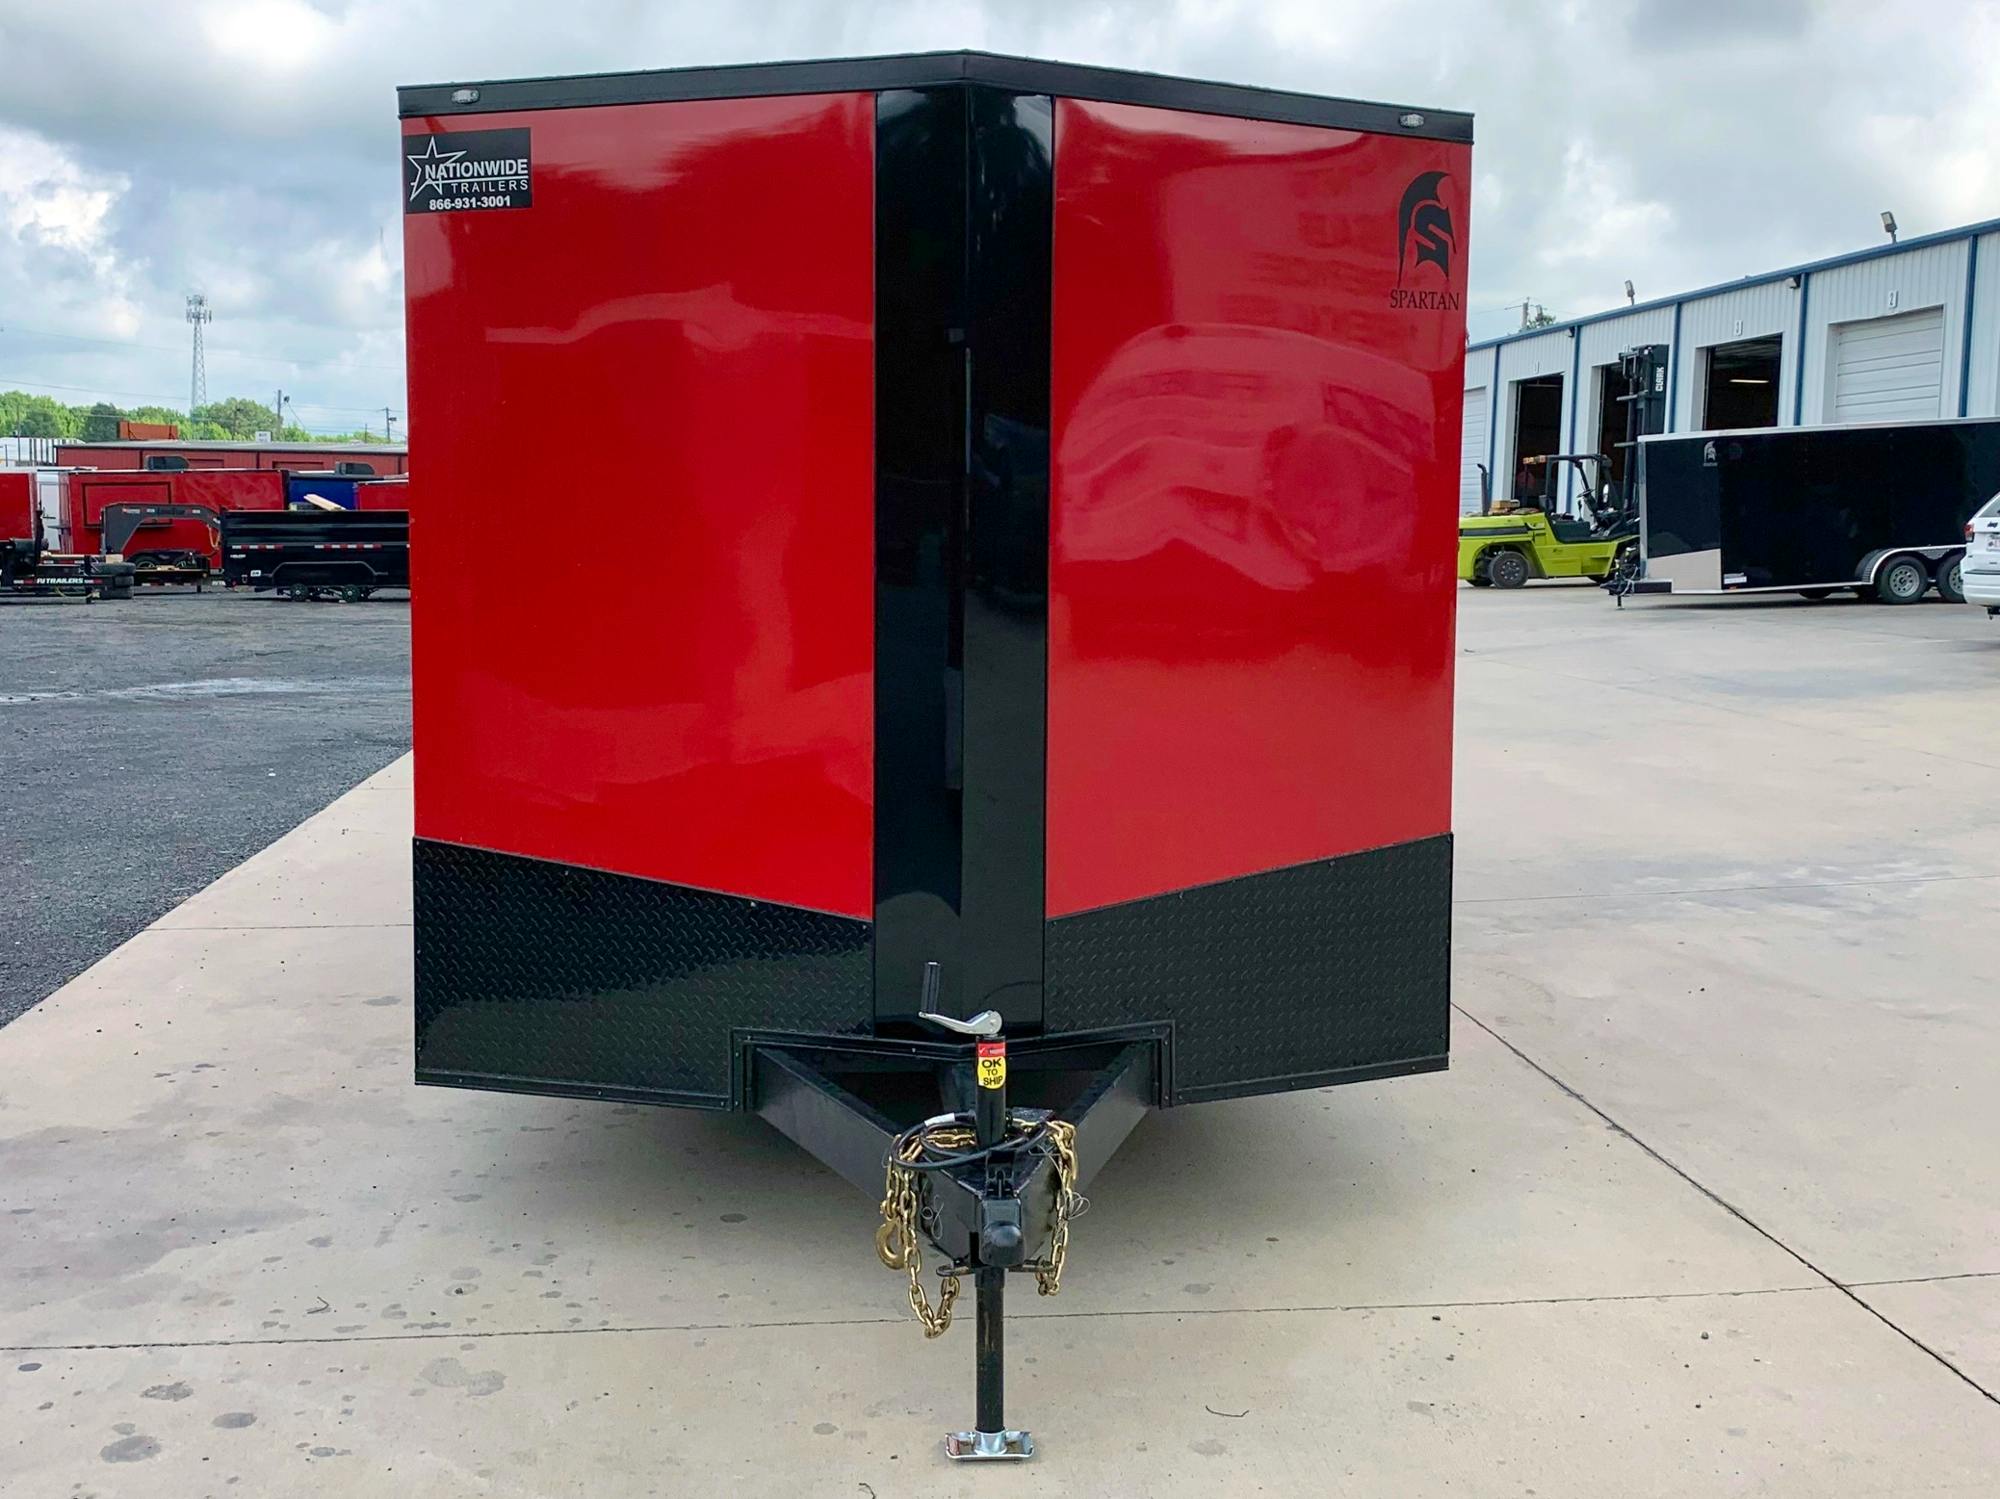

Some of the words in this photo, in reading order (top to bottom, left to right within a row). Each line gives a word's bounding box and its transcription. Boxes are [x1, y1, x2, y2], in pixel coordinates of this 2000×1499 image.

[425, 158, 528, 179] NATIONWIDE
[451, 180, 529, 194] TRAILERS
[429, 195, 511, 210] 866-931-3001
[1390, 289, 1459, 311] SPARTAN
[1655, 366, 1664, 392] CLARK
[982, 1058, 1002, 1068] OK
[983, 1075, 1003, 1086] SHIP
